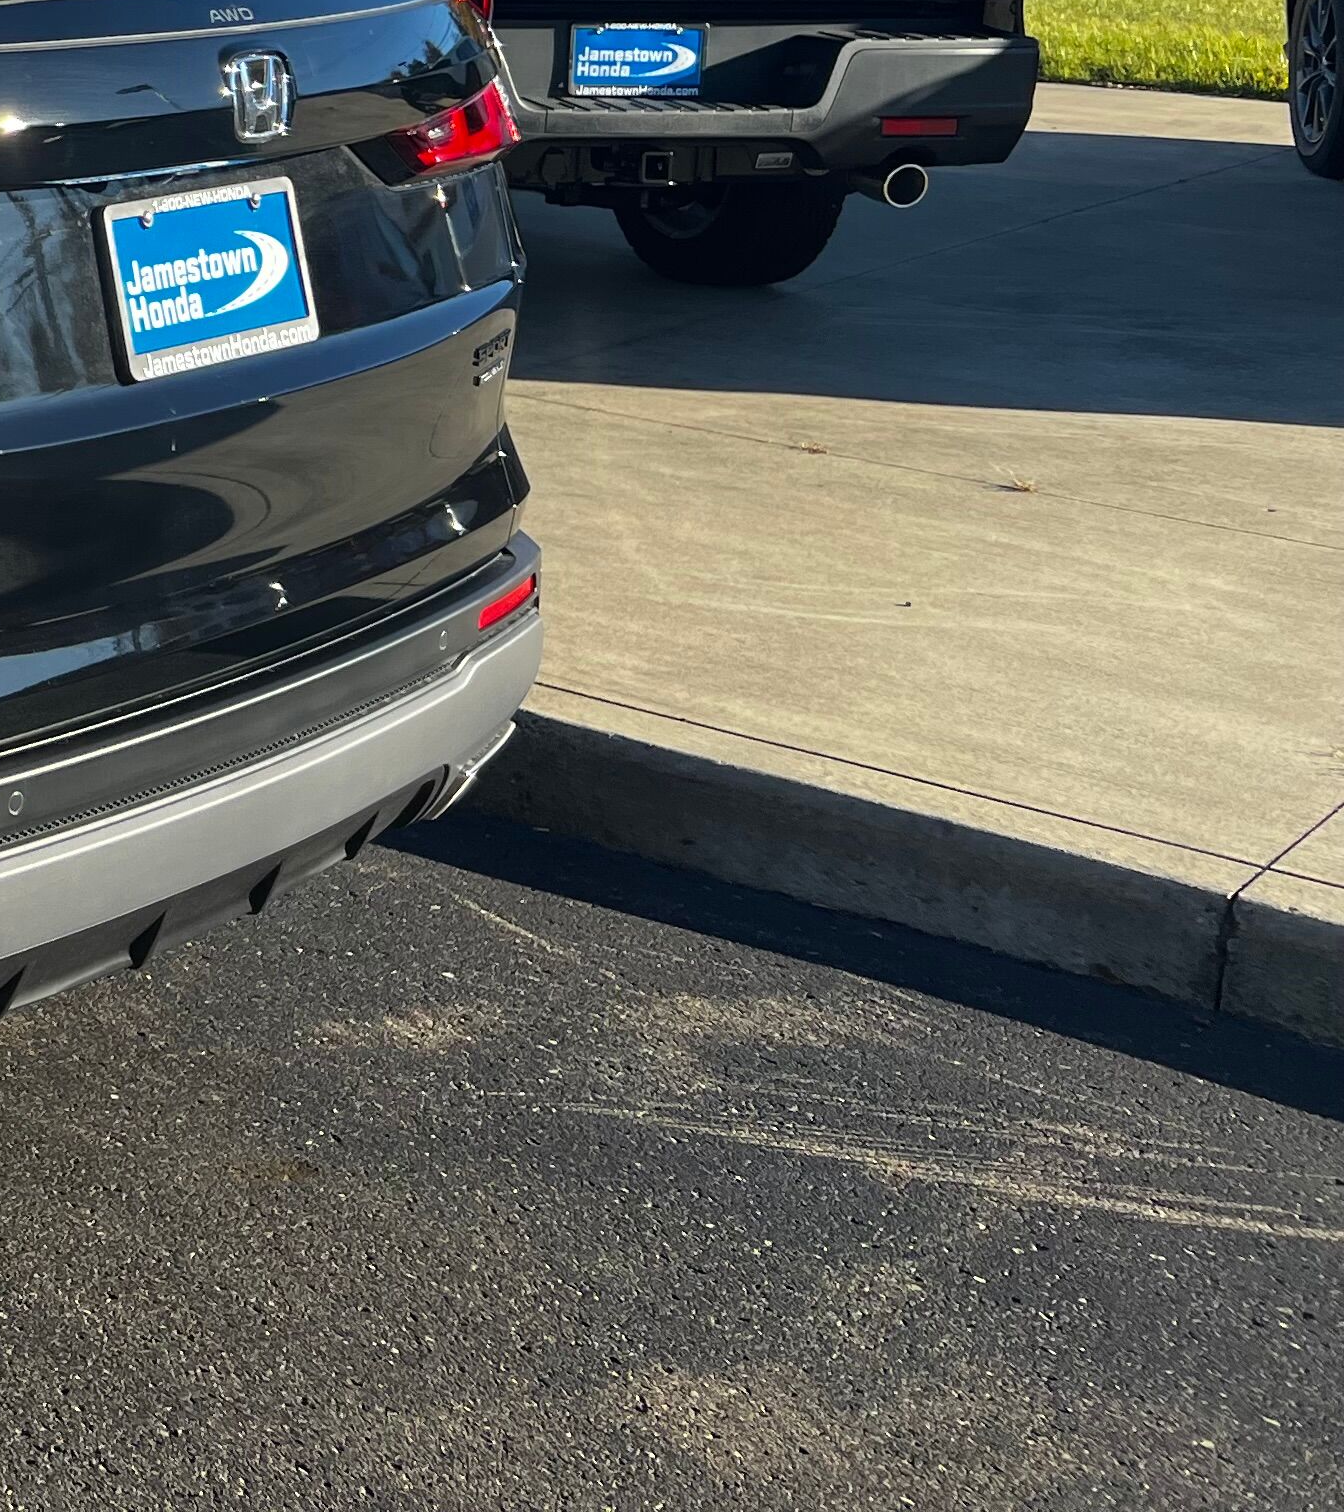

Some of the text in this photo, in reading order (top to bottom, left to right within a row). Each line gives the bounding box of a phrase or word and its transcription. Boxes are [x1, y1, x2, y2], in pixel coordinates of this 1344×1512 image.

[209, 7, 255, 25] AWD
[577, 46, 674, 64] Jamestown
[576, 61, 631, 78] Honda
[575, 84, 699, 96] JamestownHonda.com
[151, 185, 252, 214] 1-800-NEW-HONDA
[125, 246, 258, 296] Jamestown
[128, 285, 205, 333] Honda
[142, 324, 311, 379] JamestownHonda.com
